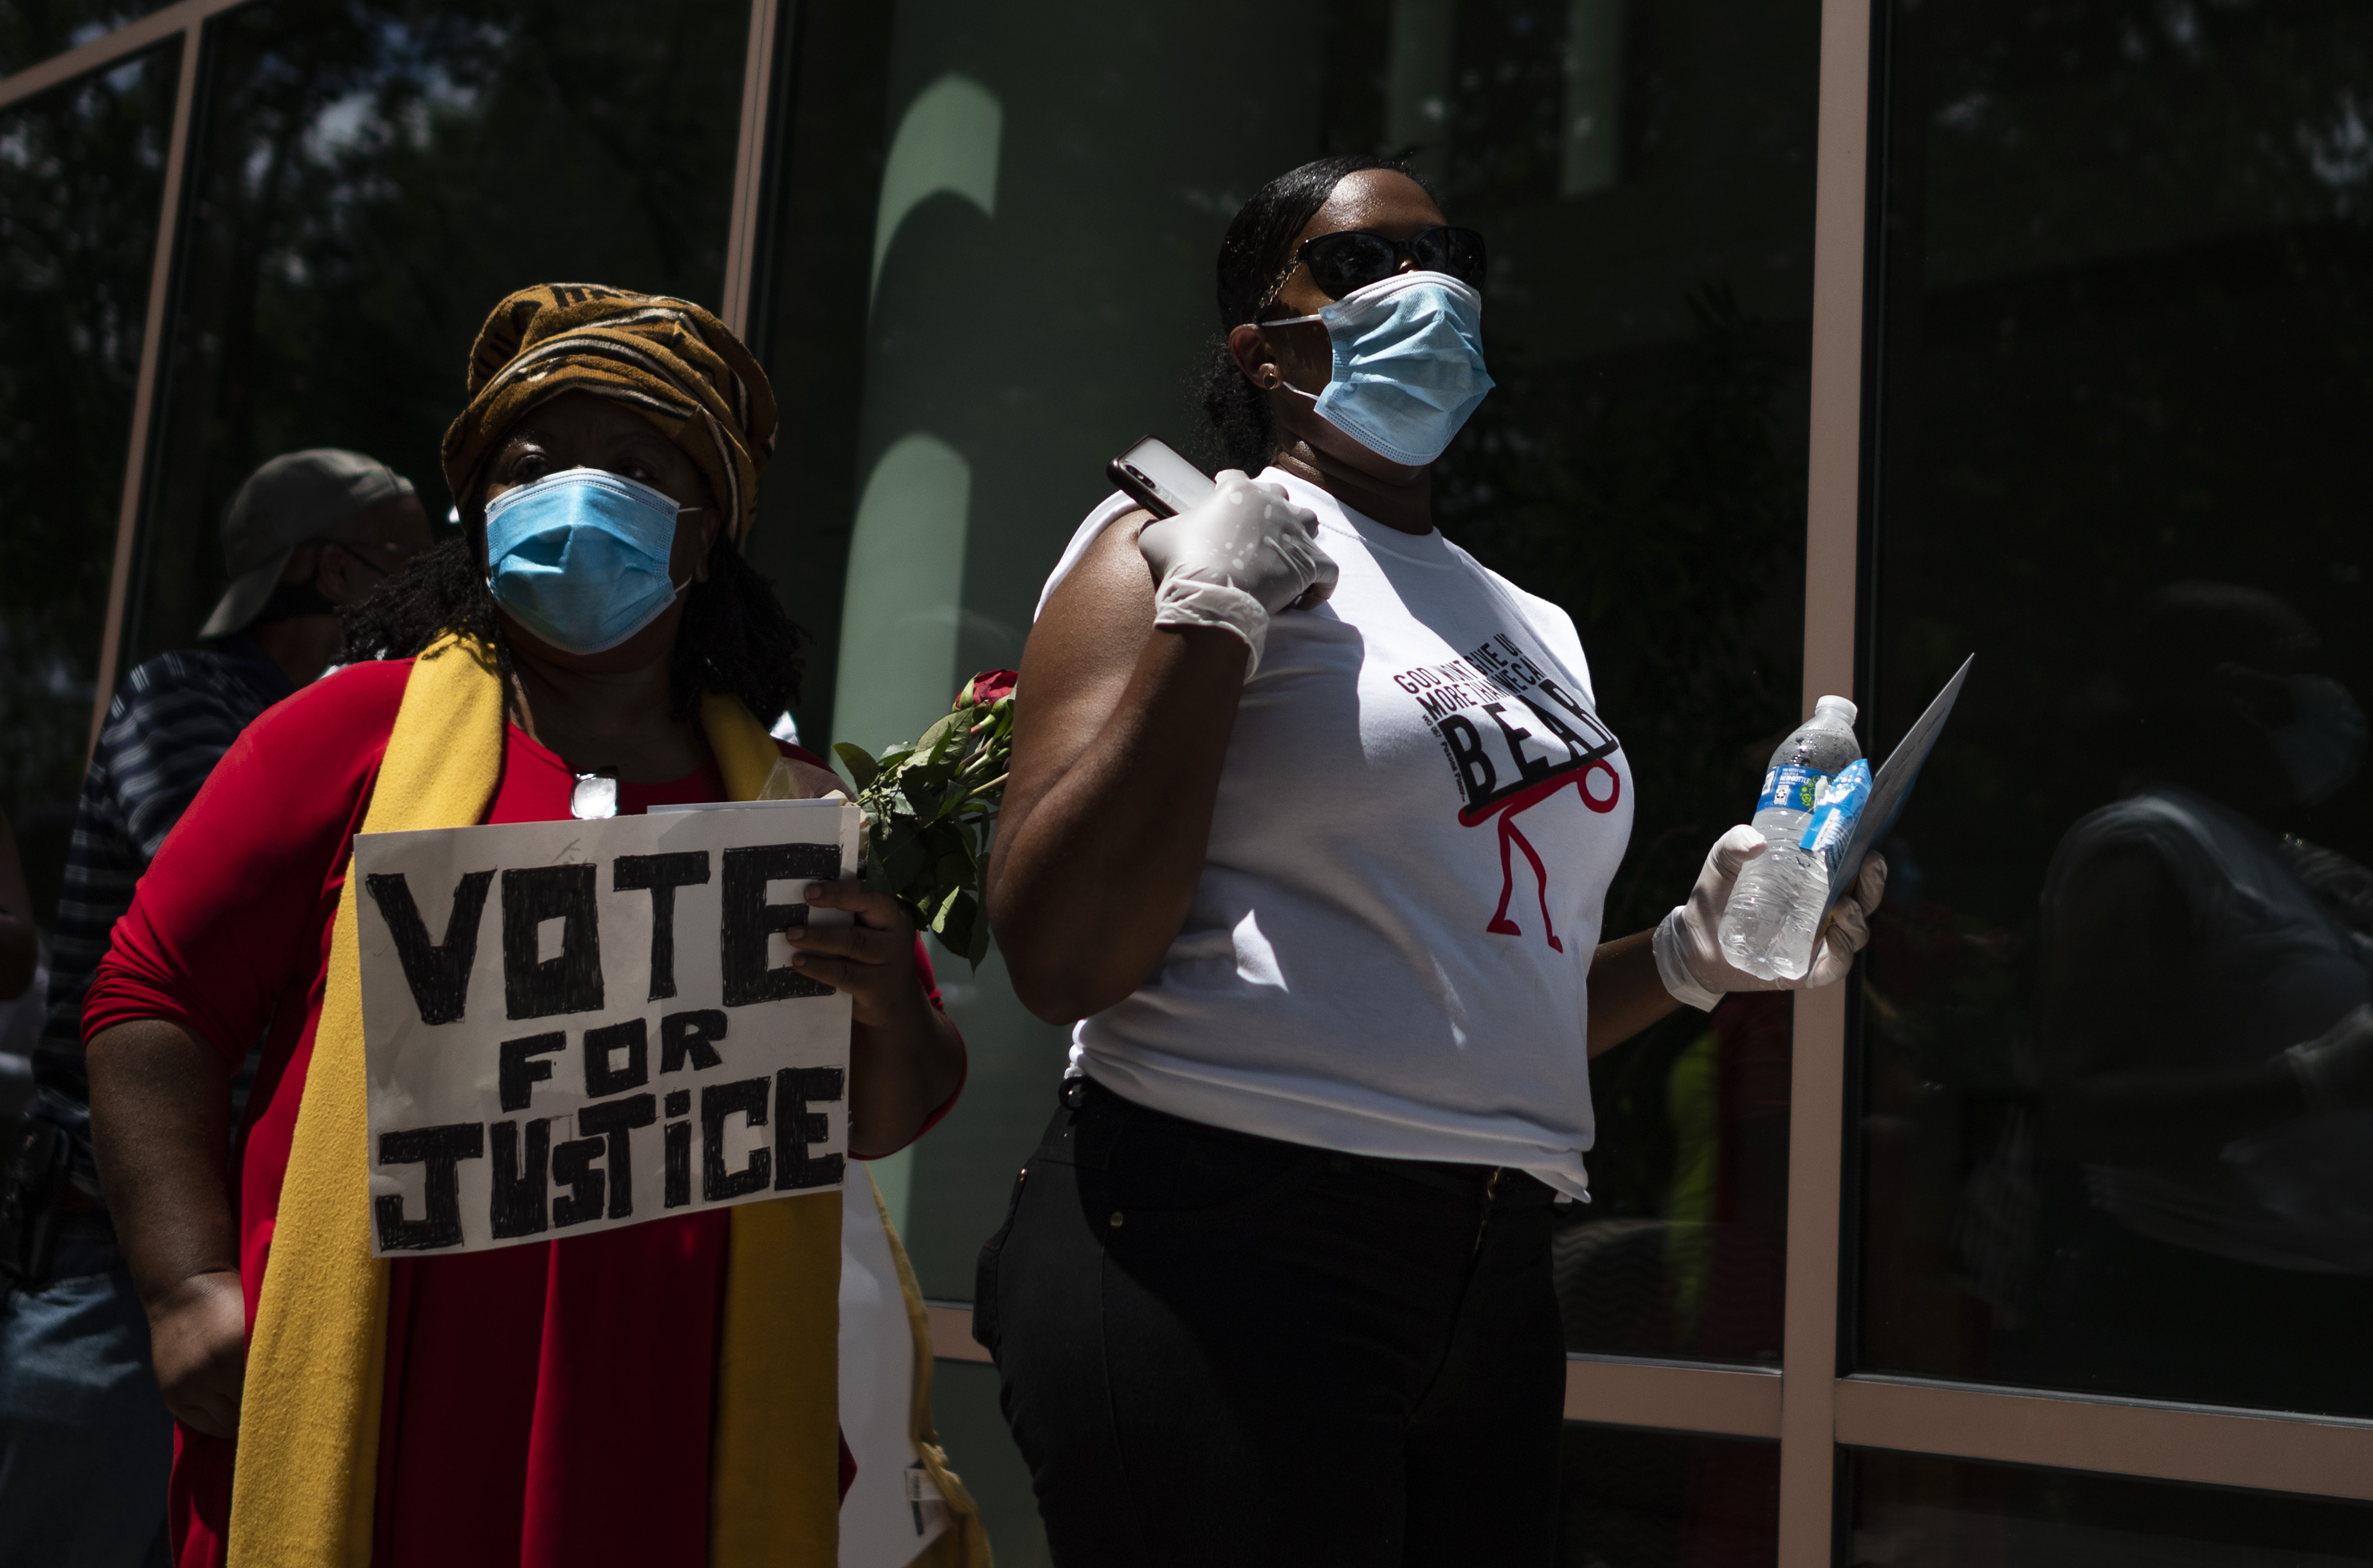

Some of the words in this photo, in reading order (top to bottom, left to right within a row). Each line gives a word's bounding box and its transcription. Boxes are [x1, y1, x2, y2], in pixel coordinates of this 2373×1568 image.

[1393, 667, 1442, 694] GOD
[1463, 642, 1509, 676] GIVE
[1415, 683, 1478, 721] MORE
[1464, 679, 1511, 703] THAN
[1491, 669, 1529, 694] WE
[1437, 678, 1620, 813] BEAR
[365, 843, 843, 1025] VOTE
[498, 1009, 729, 1113] FOR
